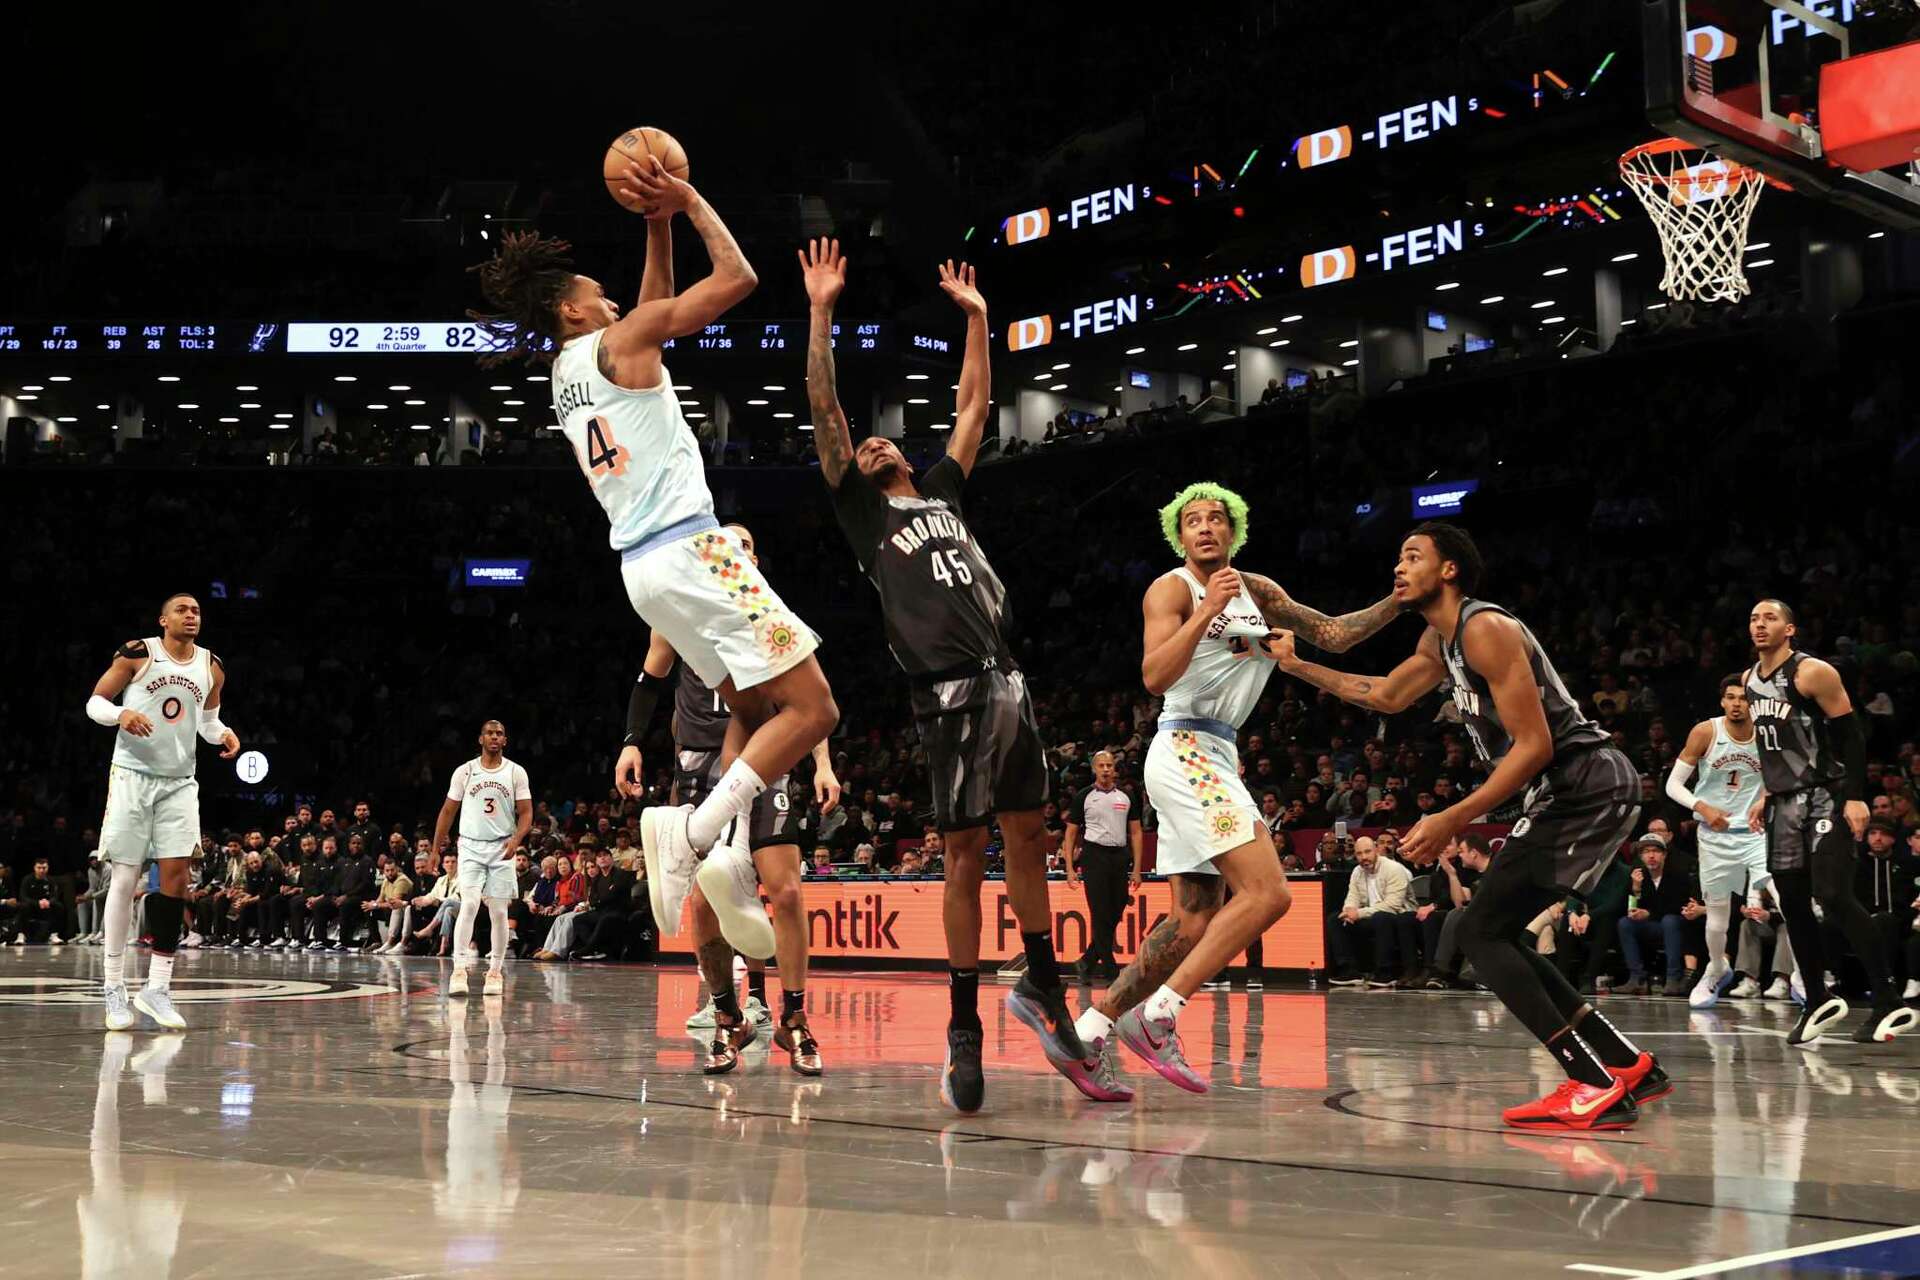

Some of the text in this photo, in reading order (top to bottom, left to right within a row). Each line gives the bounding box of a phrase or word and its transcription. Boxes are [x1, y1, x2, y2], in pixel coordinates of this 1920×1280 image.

[53, 326, 67, 336] FT
[103, 326, 127, 336] REB
[142, 326, 165, 336] AST
[180, 326, 205, 336] FLS:
[208, 326, 215, 336] 3
[329, 327, 359, 348] 92
[383, 326, 420, 341] 2:59
[445, 327, 476, 348] 82
[705, 325, 880, 335] 3PT FT AST
[107, 339, 121, 349] 39
[147, 339, 160, 349] 26
[179, 339, 205, 349] TOL:
[207, 339, 214, 349] 2
[376, 343, 427, 352] 4th Quarter
[862, 338, 875, 348] 20
[913, 335, 948, 352] 9:54 PM
[587, 417, 618, 470] 4
[890, 513, 969, 556] BROOKLYN
[930, 547, 974, 588] 45
[1207, 613, 1232, 640] SAN
[146, 674, 204, 704] SAN ANTONIO
[162, 696, 182, 720] 0
[1758, 725, 1783, 751] 22
[1727, 769, 1738, 786] 1
[470, 782, 483, 798] SAN
[483, 798, 495, 814] 3
